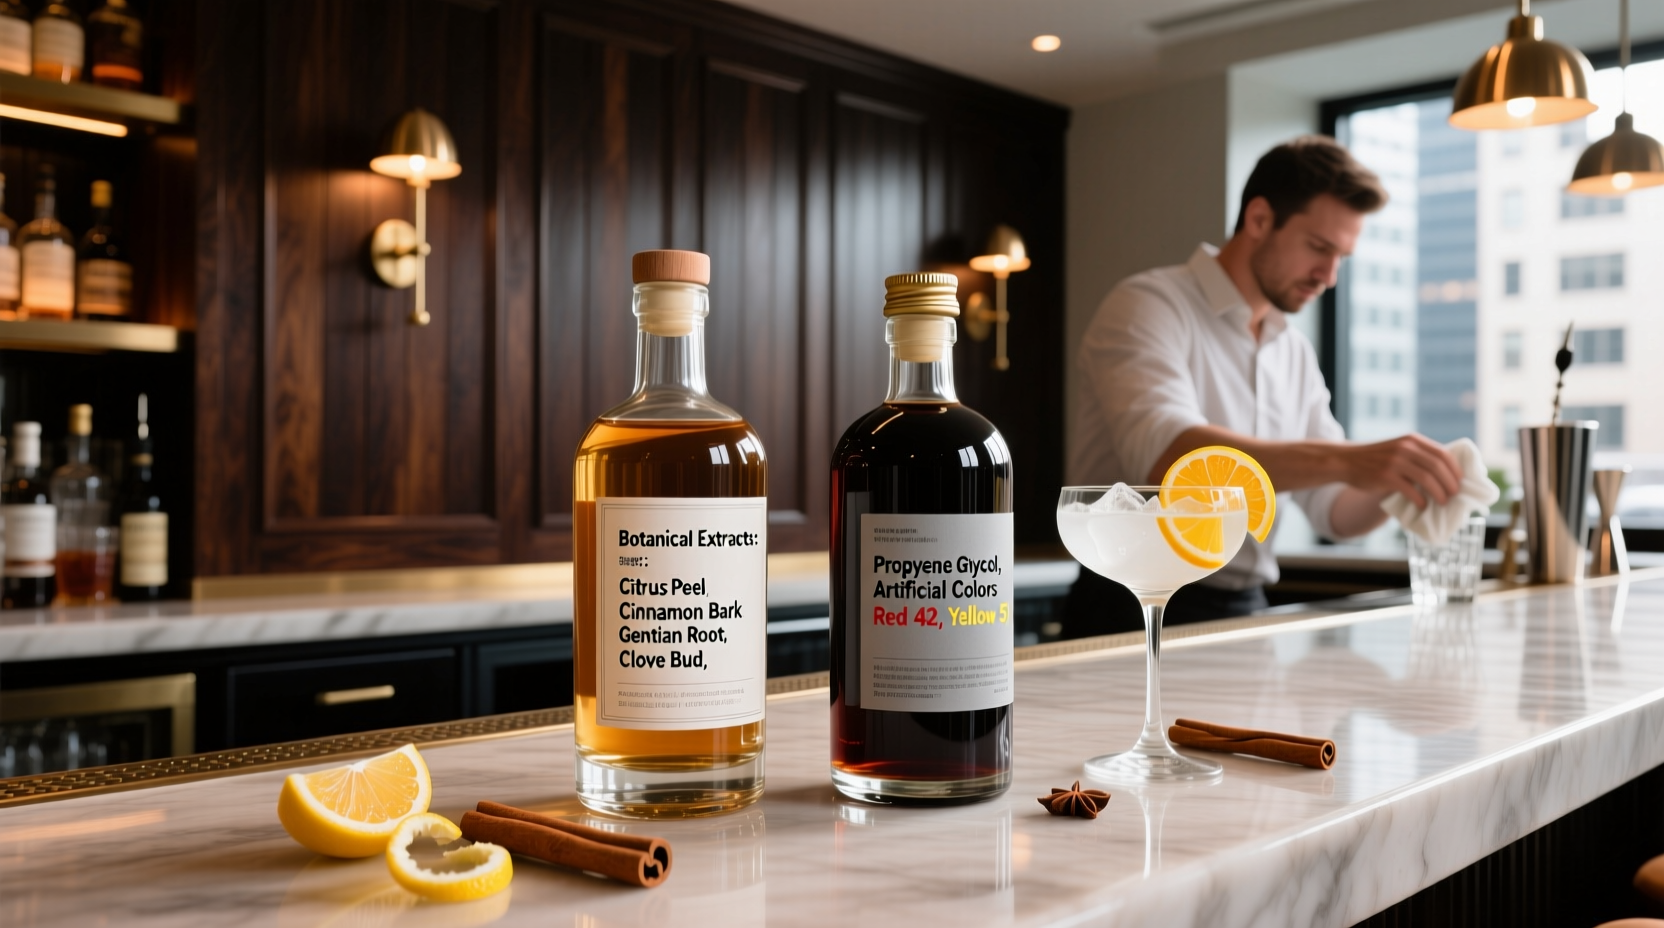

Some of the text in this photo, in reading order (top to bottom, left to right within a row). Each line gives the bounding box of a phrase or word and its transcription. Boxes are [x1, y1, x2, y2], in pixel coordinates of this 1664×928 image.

[619, 529, 759, 547] Botanical Extracts:
[873, 555, 953, 578] Propyene
[619, 577, 709, 597] Citrus Peel,
[873, 580, 998, 600] Artificial Colors
[619, 600, 743, 621] Cinnamon Bark
[873, 606, 908, 626] Red
[913, 606, 944, 630] 42,
[948, 606, 996, 626] Yellow
[619, 626, 728, 644] Gentian Root,
[619, 650, 708, 671] Clove Bud,
